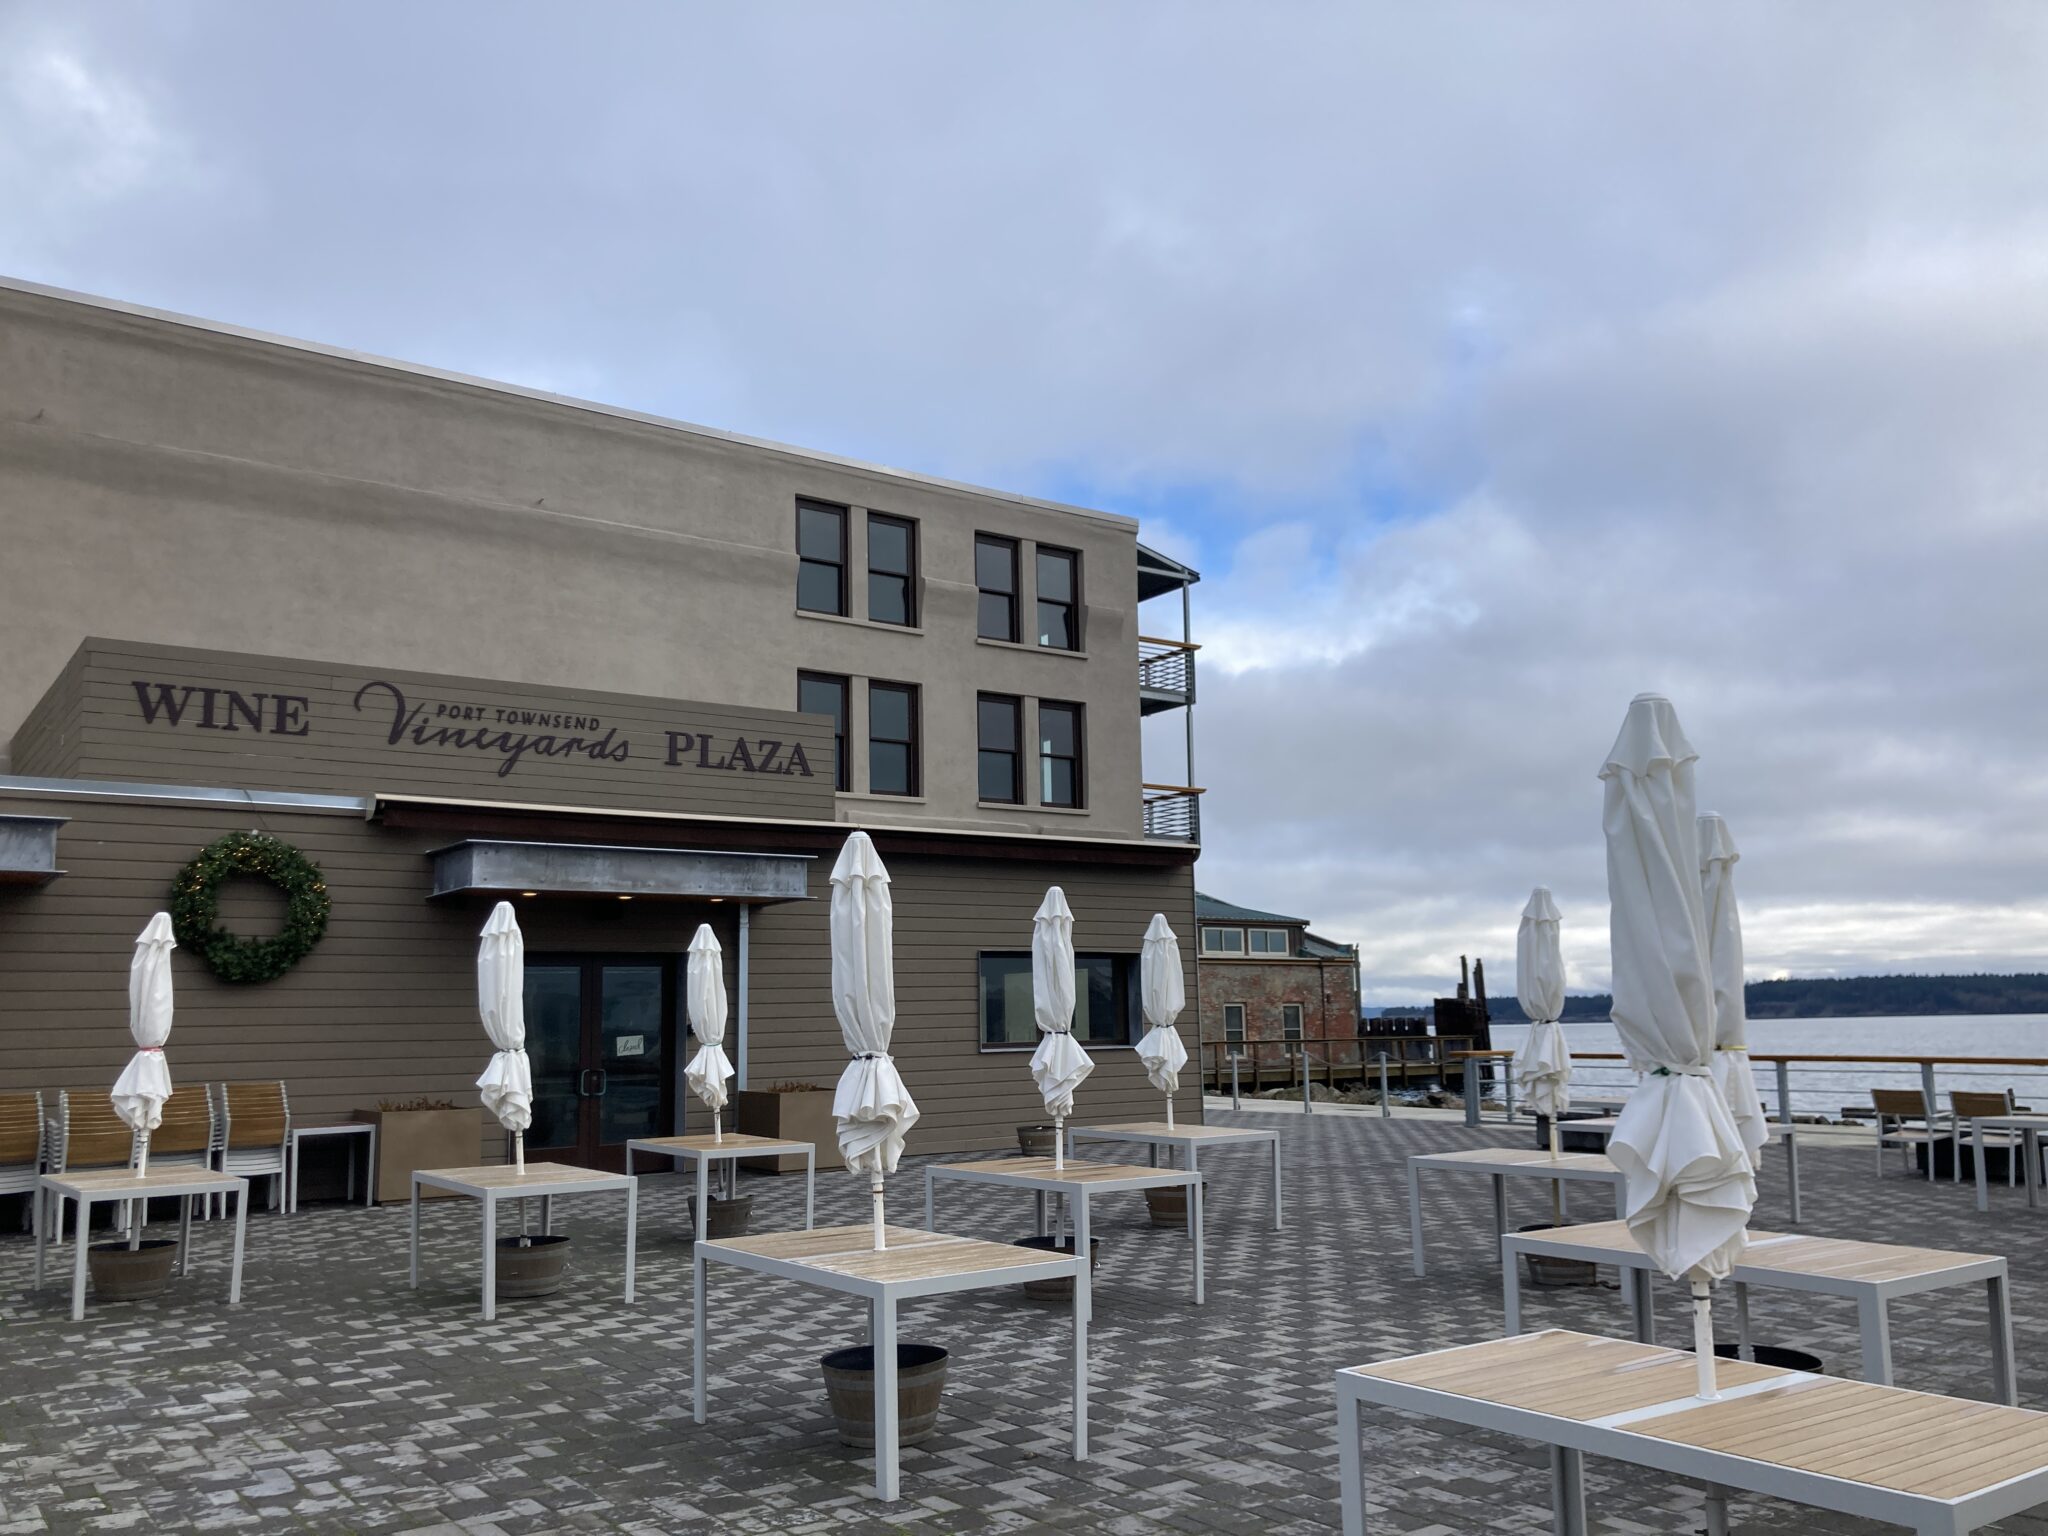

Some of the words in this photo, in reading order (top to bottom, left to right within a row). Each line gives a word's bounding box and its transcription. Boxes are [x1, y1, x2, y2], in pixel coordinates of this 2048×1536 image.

[131, 680, 309, 736] WINE
[354, 681, 629, 777] Vineyards
[437, 703, 485, 721] PORT
[495, 708, 600, 731] TOWNSEND
[664, 730, 814, 776] PLAZA
